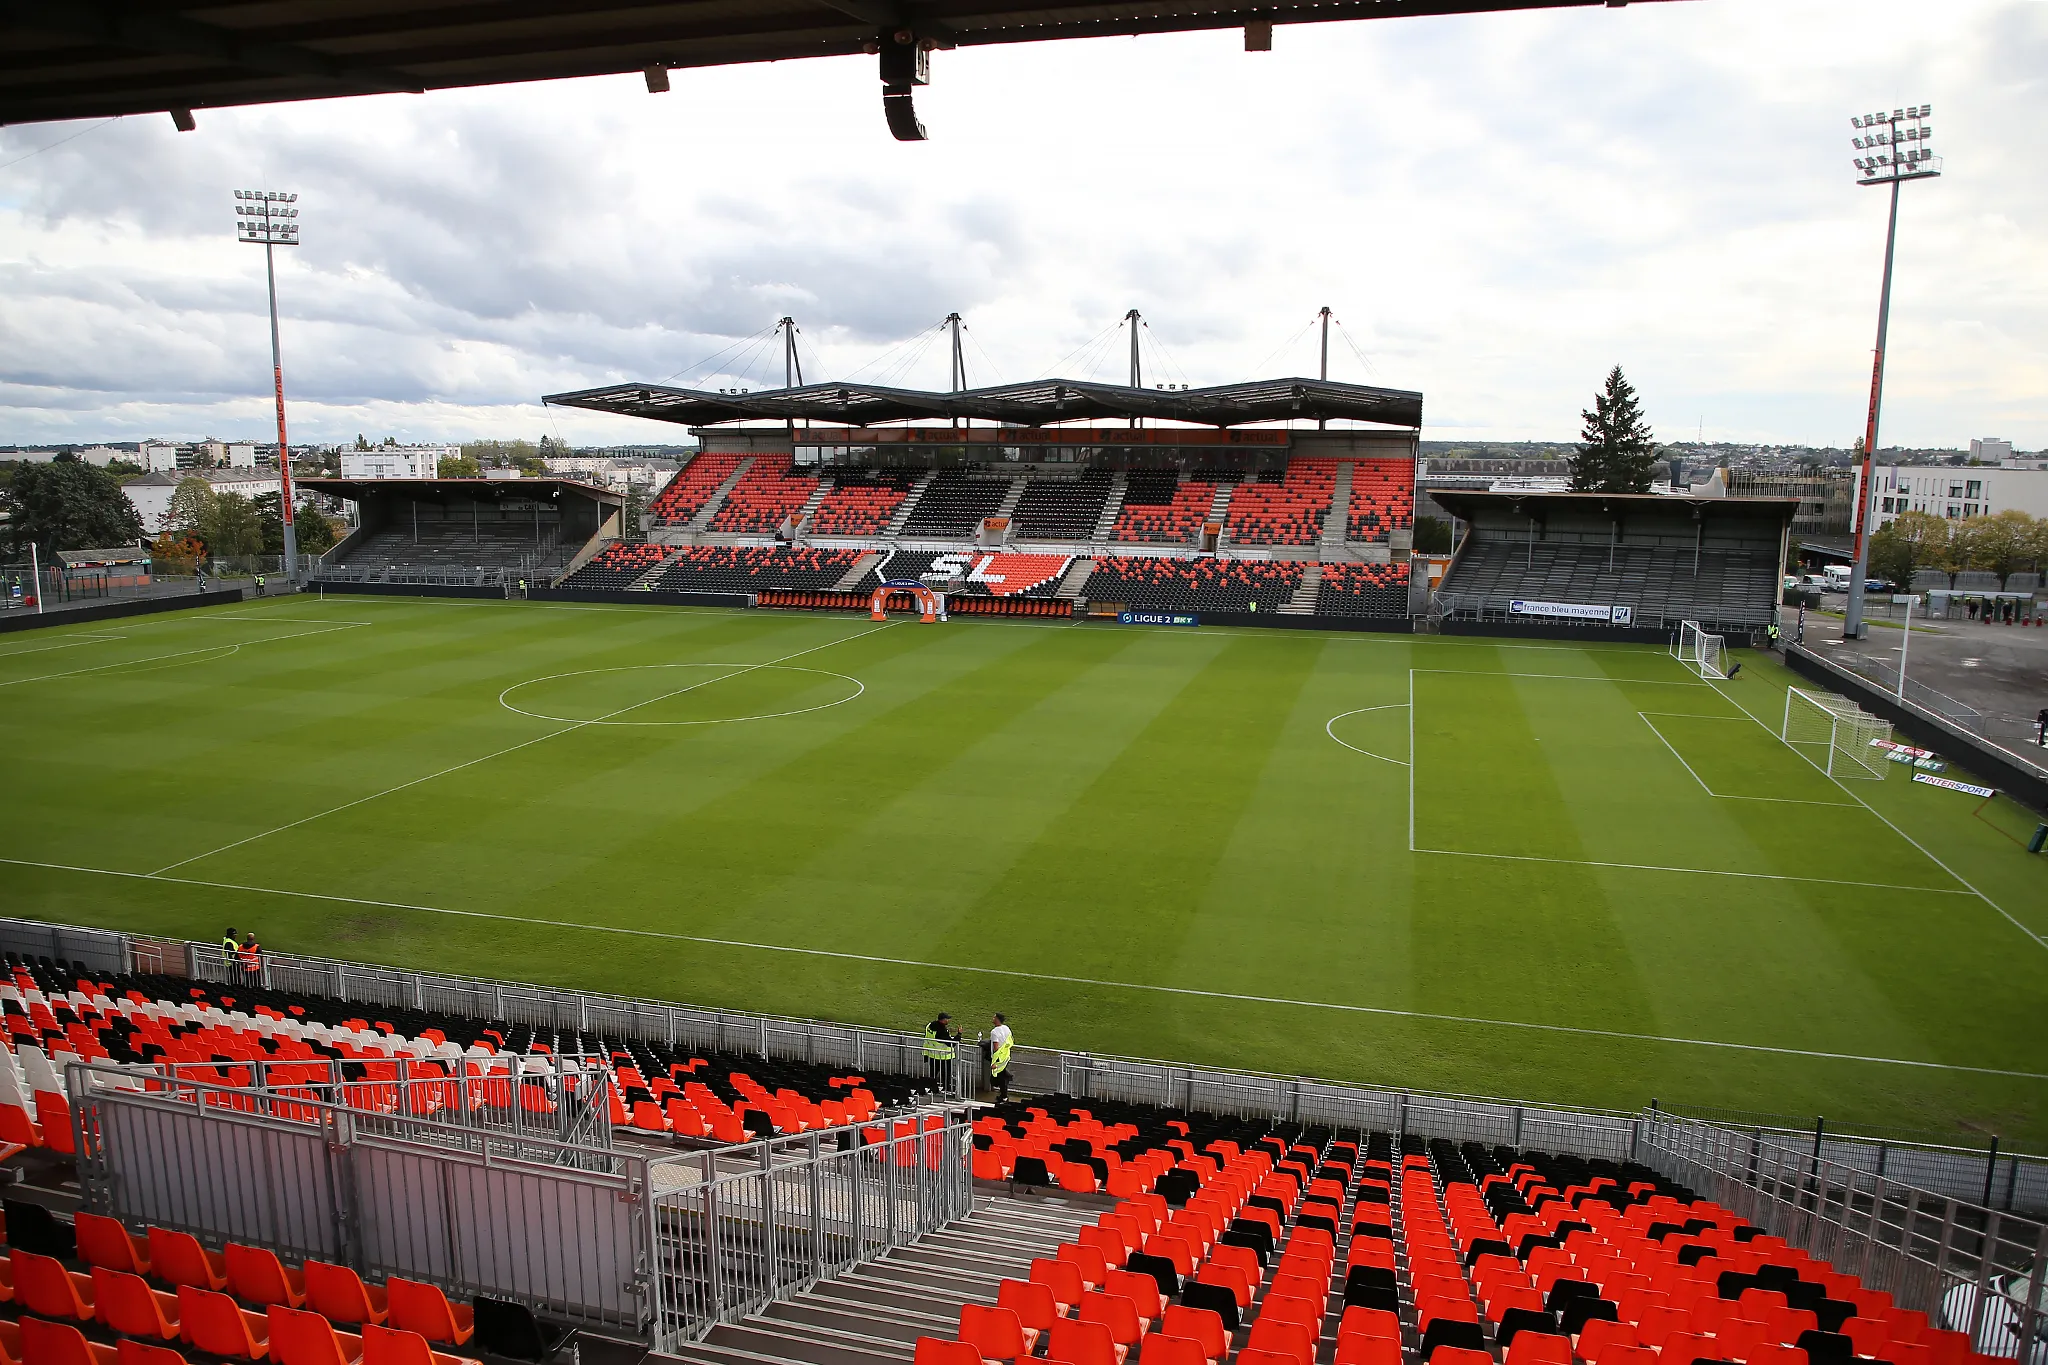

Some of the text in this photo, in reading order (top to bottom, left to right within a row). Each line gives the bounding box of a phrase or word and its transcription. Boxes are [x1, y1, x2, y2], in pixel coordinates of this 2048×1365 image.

[276, 376, 284, 432] actual
[1113, 430, 1146, 441] actual
[1242, 431, 1278, 442] actual
[281, 461, 290, 515] actual
[1523, 603, 1549, 613] france
[1551, 604, 1569, 614] bleu
[1571, 607, 1610, 617] mayenne
[1134, 614, 1193, 624] LIGUE 2 BKT
[1887, 750, 1913, 764] BKT
[1914, 758, 1942, 770] BKT
[1924, 776, 1991, 796] INTERSPORT
